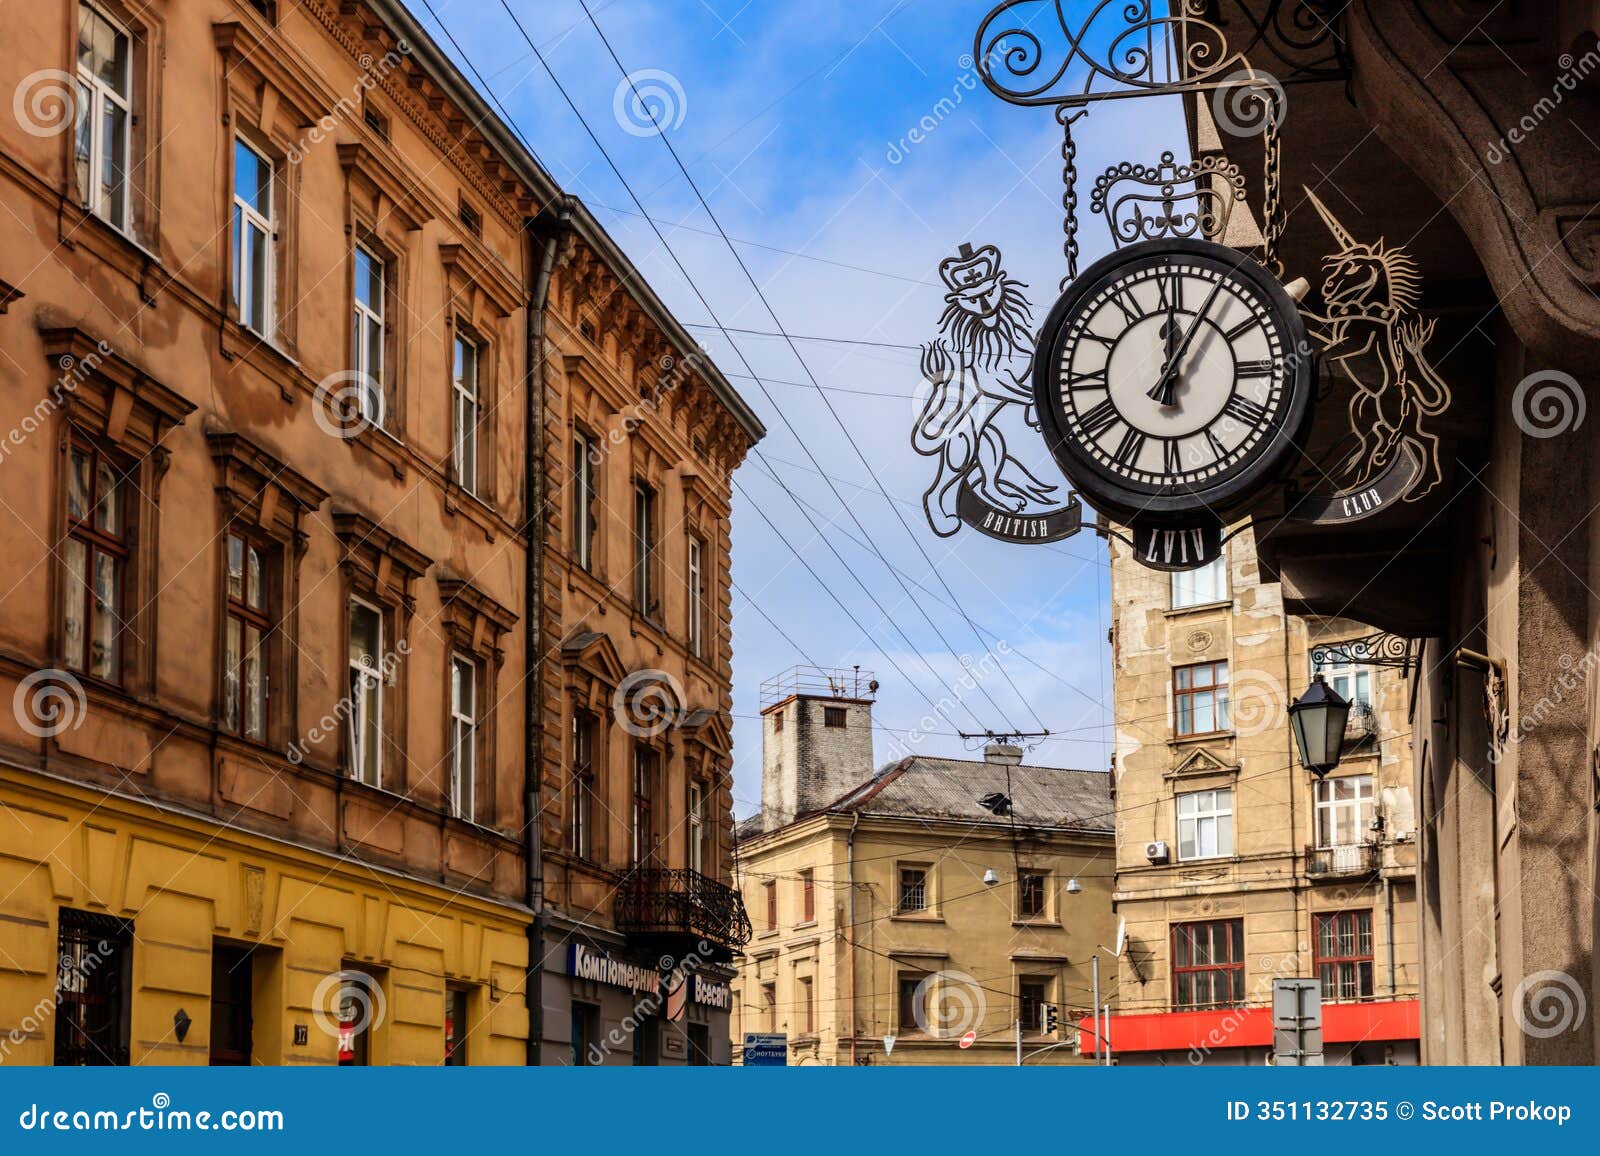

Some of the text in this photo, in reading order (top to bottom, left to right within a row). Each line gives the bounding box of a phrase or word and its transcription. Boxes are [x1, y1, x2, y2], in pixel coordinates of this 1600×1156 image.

[1343, 488, 1383, 517] CLUB
[982, 514, 1049, 537] BRITISH
[1145, 528, 1204, 563] LVIV
[695, 974, 729, 1009] Всесвіт
